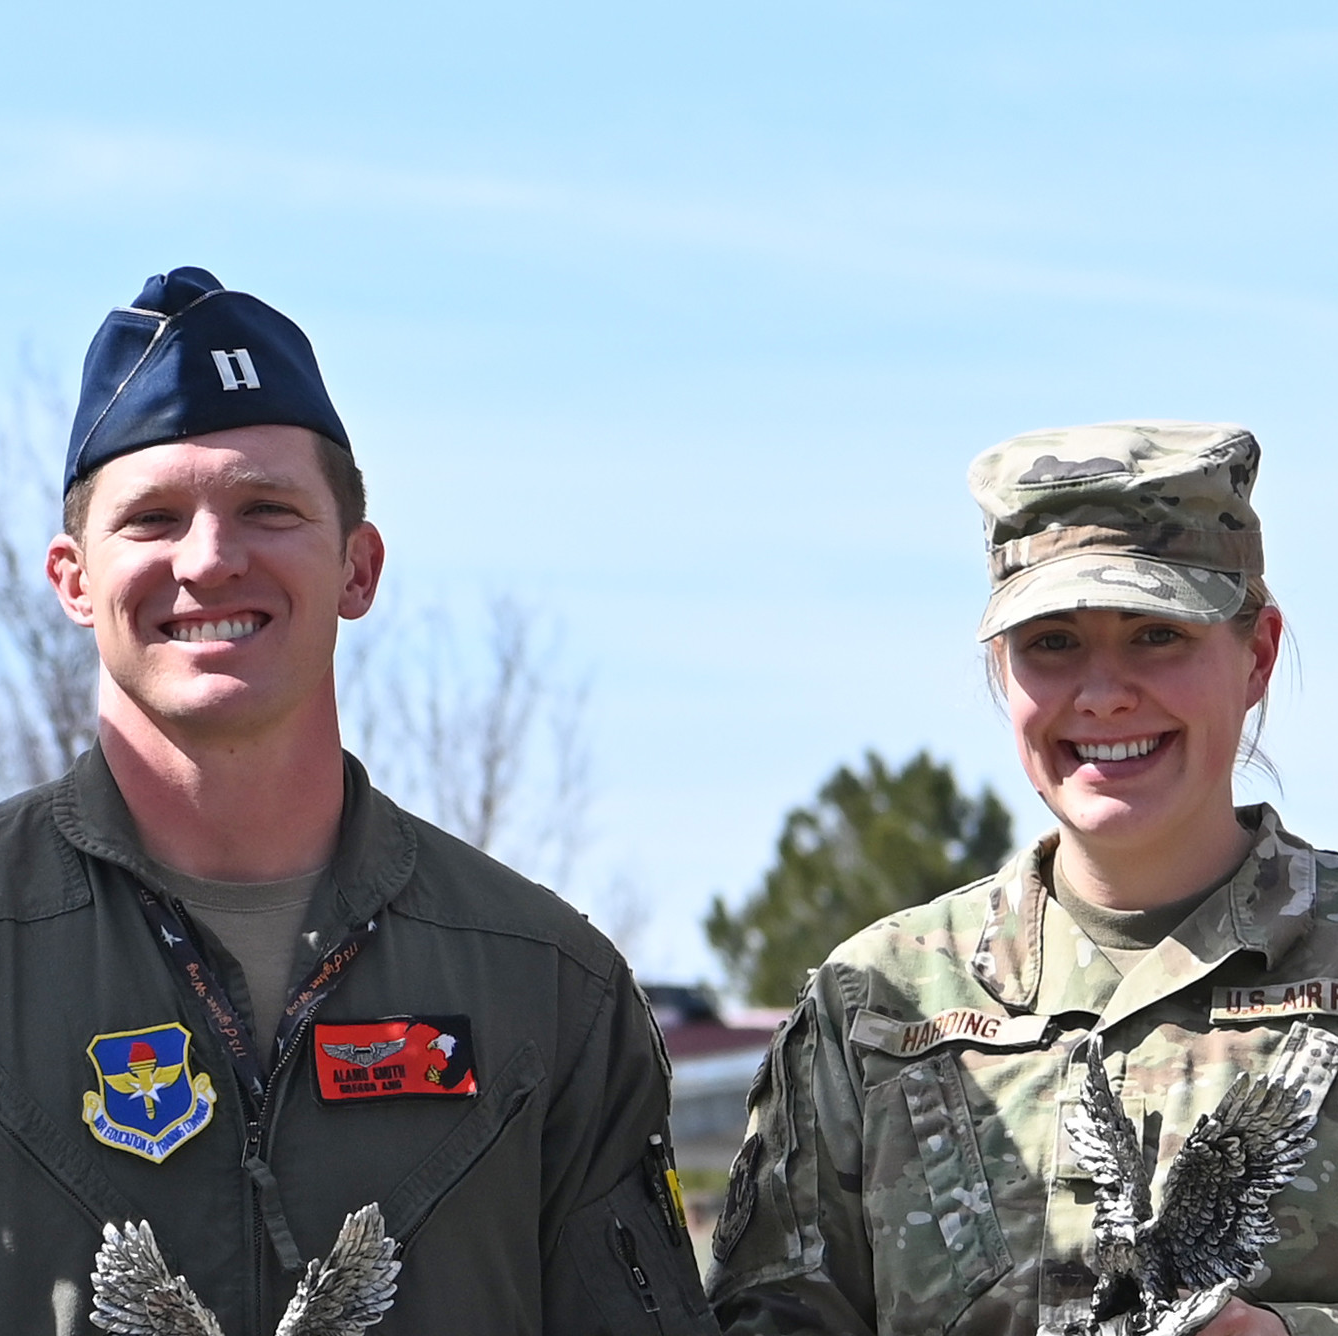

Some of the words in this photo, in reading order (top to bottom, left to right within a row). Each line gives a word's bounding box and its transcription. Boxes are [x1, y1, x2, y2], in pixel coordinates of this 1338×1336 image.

[1225, 989, 1272, 1015] U.S.
[1282, 985, 1322, 1012] AIR
[902, 1011, 1001, 1052] HARDING
[373, 1065, 406, 1081] SMITH
